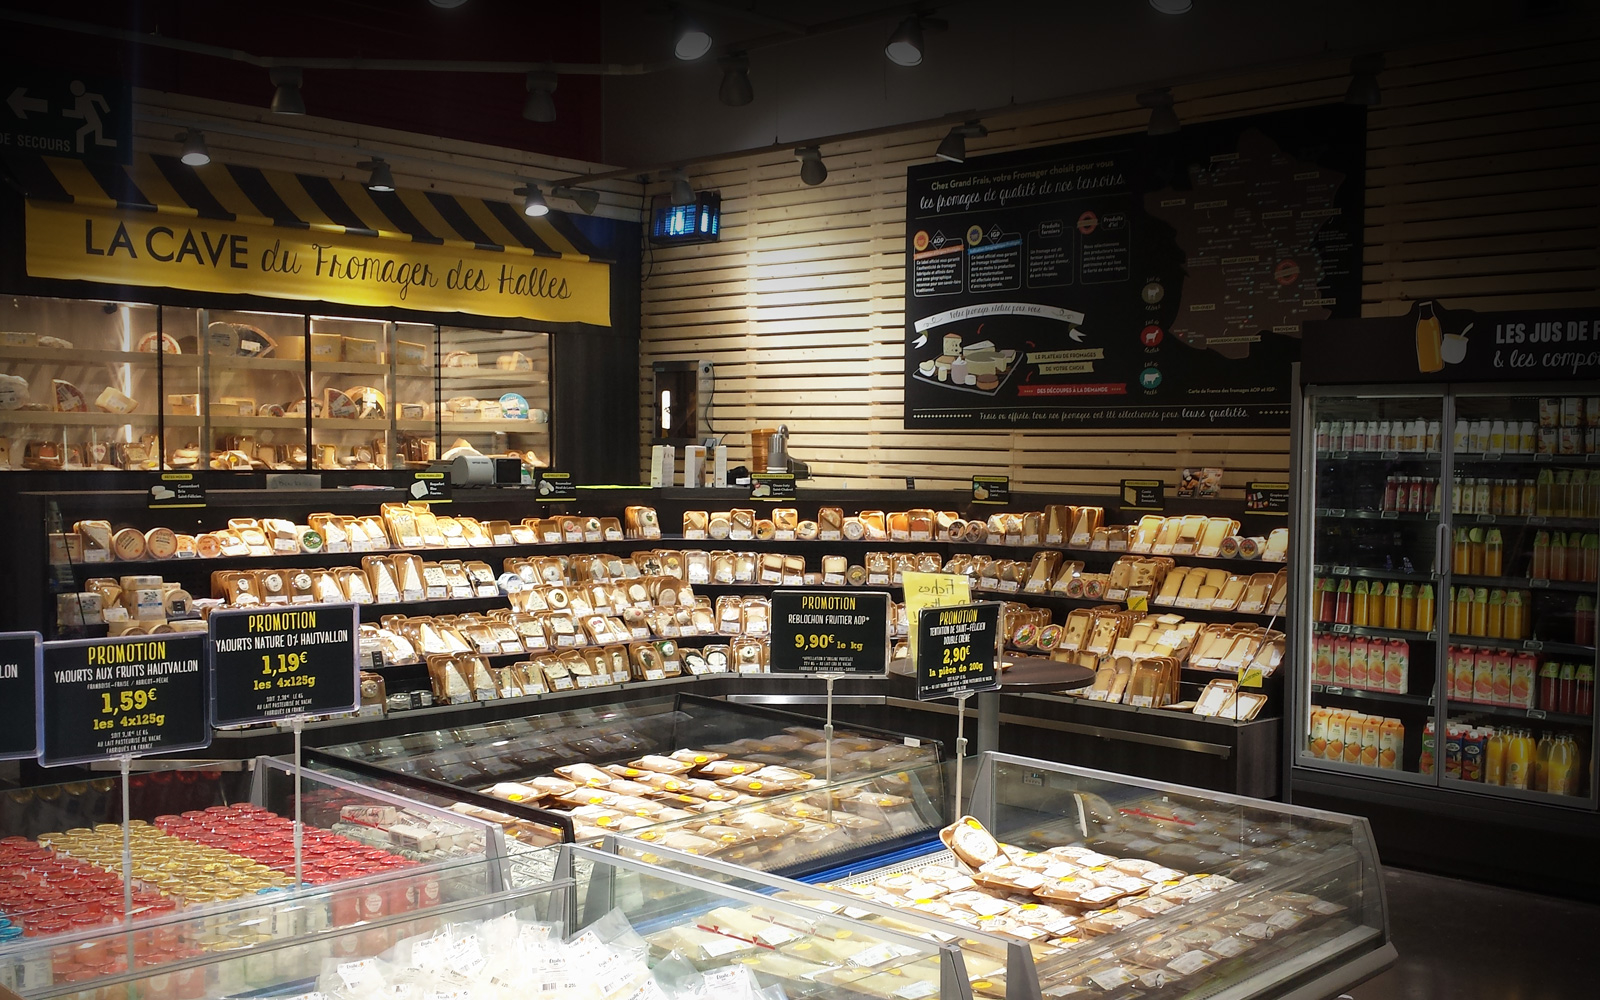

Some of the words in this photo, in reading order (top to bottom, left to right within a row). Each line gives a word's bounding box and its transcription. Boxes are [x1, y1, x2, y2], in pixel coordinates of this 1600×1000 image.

[17, 134, 70, 152] SECOURS
[932, 180, 949, 191] Chez
[950, 178, 972, 188] Grand
[992, 174, 1011, 183] votre
[1013, 169, 1048, 183] Fromager
[1050, 164, 1075, 176] choisit
[1076, 163, 1094, 175] pour
[1096, 160, 1114, 169] vous
[936, 192, 981, 213] fromages
[984, 188, 996, 202] de
[999, 183, 1036, 206] qualité
[1040, 181, 1052, 194] de
[1055, 181, 1073, 193] nos
[85, 220, 138, 258] LA
[145, 228, 248, 270] CAVE
[261, 239, 301, 275] du
[312, 244, 439, 300] Fromager
[446, 258, 490, 292] des
[499, 264, 572, 300] Halles
[1496, 323, 1526, 345] LES
[1529, 322, 1563, 343] JUS
[1566, 320, 1588, 342] DE
[1493, 350, 1504, 368] &
[1510, 349, 1538, 368] les
[1542, 351, 1600, 375] compo
[1182, 408, 1207, 419] leurs
[802, 596, 856, 611] PROMOTION
[248, 610, 317, 633] PROMOTION
[788, 614, 824, 624] REBLOCHON
[825, 614, 853, 625] FRUITIER
[940, 610, 978, 626] PROMOTION
[216, 637, 252, 653] YAOURTS
[254, 634, 285, 650] NATURE
[287, 634, 299, 647] 0%
[300, 630, 348, 646] HAUTVALLON
[794, 634, 835, 651] 9,90€
[837, 641, 847, 649] le
[850, 641, 864, 652] kg
[88, 641, 166, 666] PROMOTION
[262, 652, 308, 677] 1,19€
[943, 646, 971, 666] 2,90€
[54, 668, 93, 684] YAOURTS
[96, 667, 113, 680] AUX
[116, 664, 145, 679] FRUITS
[147, 660, 199, 676] HAUTVALLON
[929, 668, 936, 677] la
[939, 664, 957, 678] pièce
[959, 662, 967, 672] de
[969, 662, 984, 672] 200g
[254, 680, 272, 691] les
[277, 675, 316, 689] 4x125g
[101, 688, 157, 716] 1,59€
[93, 719, 114, 730] les
[120, 713, 165, 727] 4x125g
